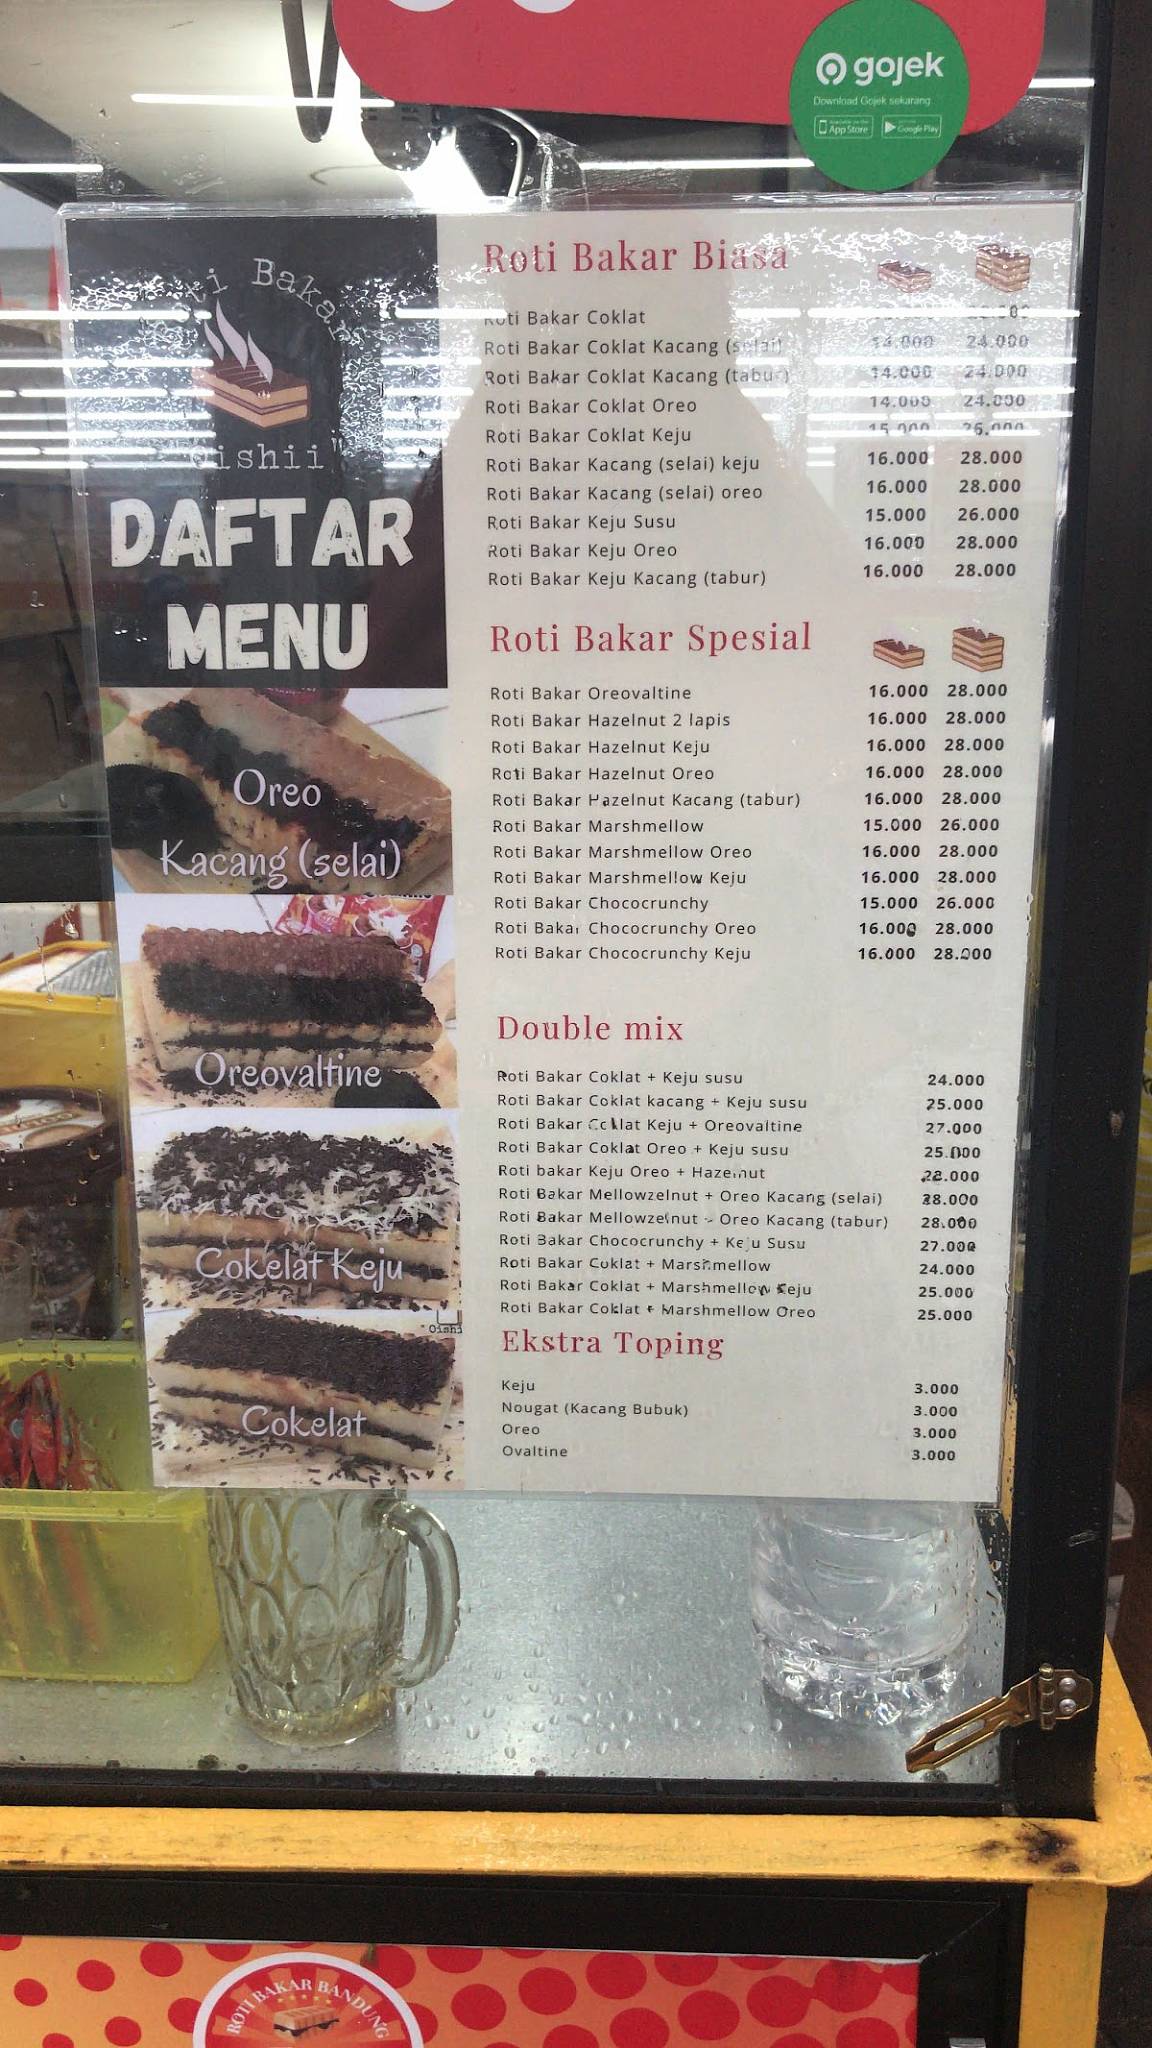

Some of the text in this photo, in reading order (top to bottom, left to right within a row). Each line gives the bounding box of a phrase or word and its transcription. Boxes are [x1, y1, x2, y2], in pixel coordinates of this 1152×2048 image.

[853, 52, 944, 86] gojek
[813, 96, 858, 106] Download
[860, 96, 886, 107] Gojek
[829, 125, 868, 135] App Store
[897, 124, 939, 135] Google Play
[484, 238, 789, 273] Roti Bakar Biasa
[485, 397, 697, 415] Roti Bakar Coklat Oreo
[485, 426, 692, 447] Roti Bakar Coklat Keju
[486, 455, 760, 476] Roti Bakar Kacang (selai) keju
[867, 449, 1023, 466] 16.000 28.000
[486, 484, 763, 505] Roti Bakar Kacang (selai) oreo
[866, 478, 1022, 495] 16.000 28.000
[865, 506, 1020, 523] 15.000 26.000
[110, 497, 414, 567] DAFTAR
[487, 514, 676, 534] Roti Bakar Keju Susu
[863, 562, 1017, 579] 16.000 28.000
[488, 569, 766, 590] Roti Bakar Keju Kacang (tabur)
[167, 603, 369, 671] MENU
[491, 622, 810, 656] Roti Bakar Spesial
[490, 685, 692, 701] Roti Bakar Oreovaltine
[868, 683, 1008, 699] 16.000 28.000
[491, 712, 731, 731] Roti Bakar Hazelnut 2 lapis
[867, 710, 1006, 726] 16.000 28.000
[491, 739, 710, 758] Roti Bakar Hazelnut Keju
[866, 737, 1005, 753] 16.000 28.000
[233, 768, 321, 807] Oreo
[492, 818, 704, 833] Roti Bakar Marshmellow
[863, 817, 1000, 832] 15.000 26.000
[493, 844, 752, 859] Roti Bakar Marshmellow Oreo
[862, 844, 999, 858] 16.000 28.000
[160, 838, 400, 890] Kacang (selai)
[494, 895, 709, 913] Roti Bakar Chococrunchy
[860, 896, 995, 910] 15.000 26.000
[495, 945, 751, 964] Roti Bakar Chococrunchy Keju
[498, 1015, 683, 1040] Double mix
[194, 1051, 382, 1089] Oreovaltine
[496, 1069, 743, 1088] Roti Bakar Coklat + Keju susu
[927, 1073, 985, 1087] 24.000
[497, 1093, 807, 1112] Roti Bakar Coklat kacang + Keju susu
[926, 1097, 984, 1112] 25.000
[498, 1186, 883, 1209] Roti Bakar Mellowzelnut + Oreo Kacang (selai)
[195, 1247, 404, 1294] Cokelat Keju
[499, 1256, 531, 1269] Roti
[537, 1256, 584, 1269] Bakar
[646, 1259, 656, 1269] +
[919, 1263, 975, 1276] 24.000
[500, 1301, 531, 1314] Roti
[537, 1301, 584, 1315] Bakar
[589, 1302, 641, 1315] Coklat
[661, 1303, 771, 1318] Marshmellow
[775, 1304, 816, 1318] Oreo
[916, 1308, 973, 1322] 25.000
[502, 1329, 724, 1360] Ekstra Toping
[501, 1379, 535, 1395] Keju
[914, 1382, 959, 1394] 3.000
[501, 1401, 689, 1418] Nougat (Kacang Bubuk)
[913, 1405, 958, 1417] 3.000
[241, 1404, 367, 1438] Cokelat
[501, 1423, 541, 1436] Oreo
[912, 1427, 957, 1439] 3.000
[502, 1444, 569, 1458] Ovaltine
[911, 1449, 956, 1461] 3.000
[226, 1979, 390, 2039] ROTI BAKAR BANDUNG
